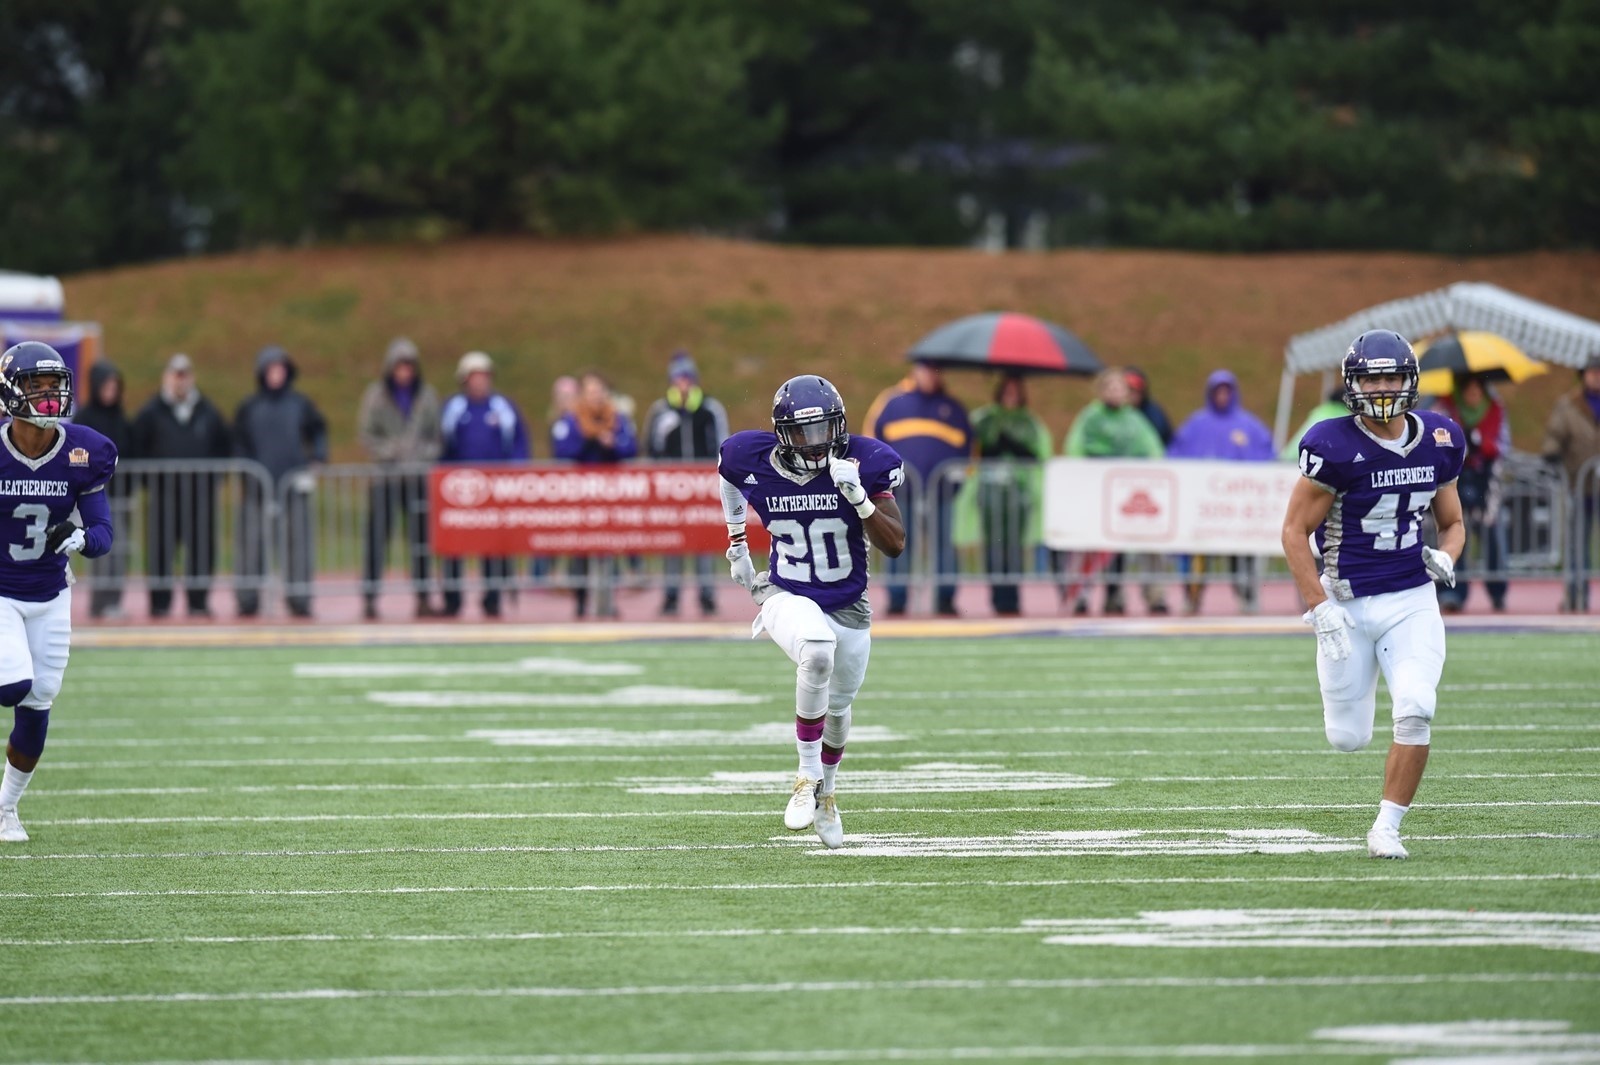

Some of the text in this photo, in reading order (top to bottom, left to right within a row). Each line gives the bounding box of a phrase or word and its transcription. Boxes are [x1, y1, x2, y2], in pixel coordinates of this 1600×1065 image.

[0, 480, 69, 496] LEATHERNECKS
[492, 472, 650, 502] WOODRUM
[1371, 466, 1435, 488] LEATHERNECKS
[766, 494, 839, 512] LEATHERNECKS
[8, 503, 50, 562] 3
[1360, 490, 1437, 551] 47
[766, 517, 854, 583] 20
